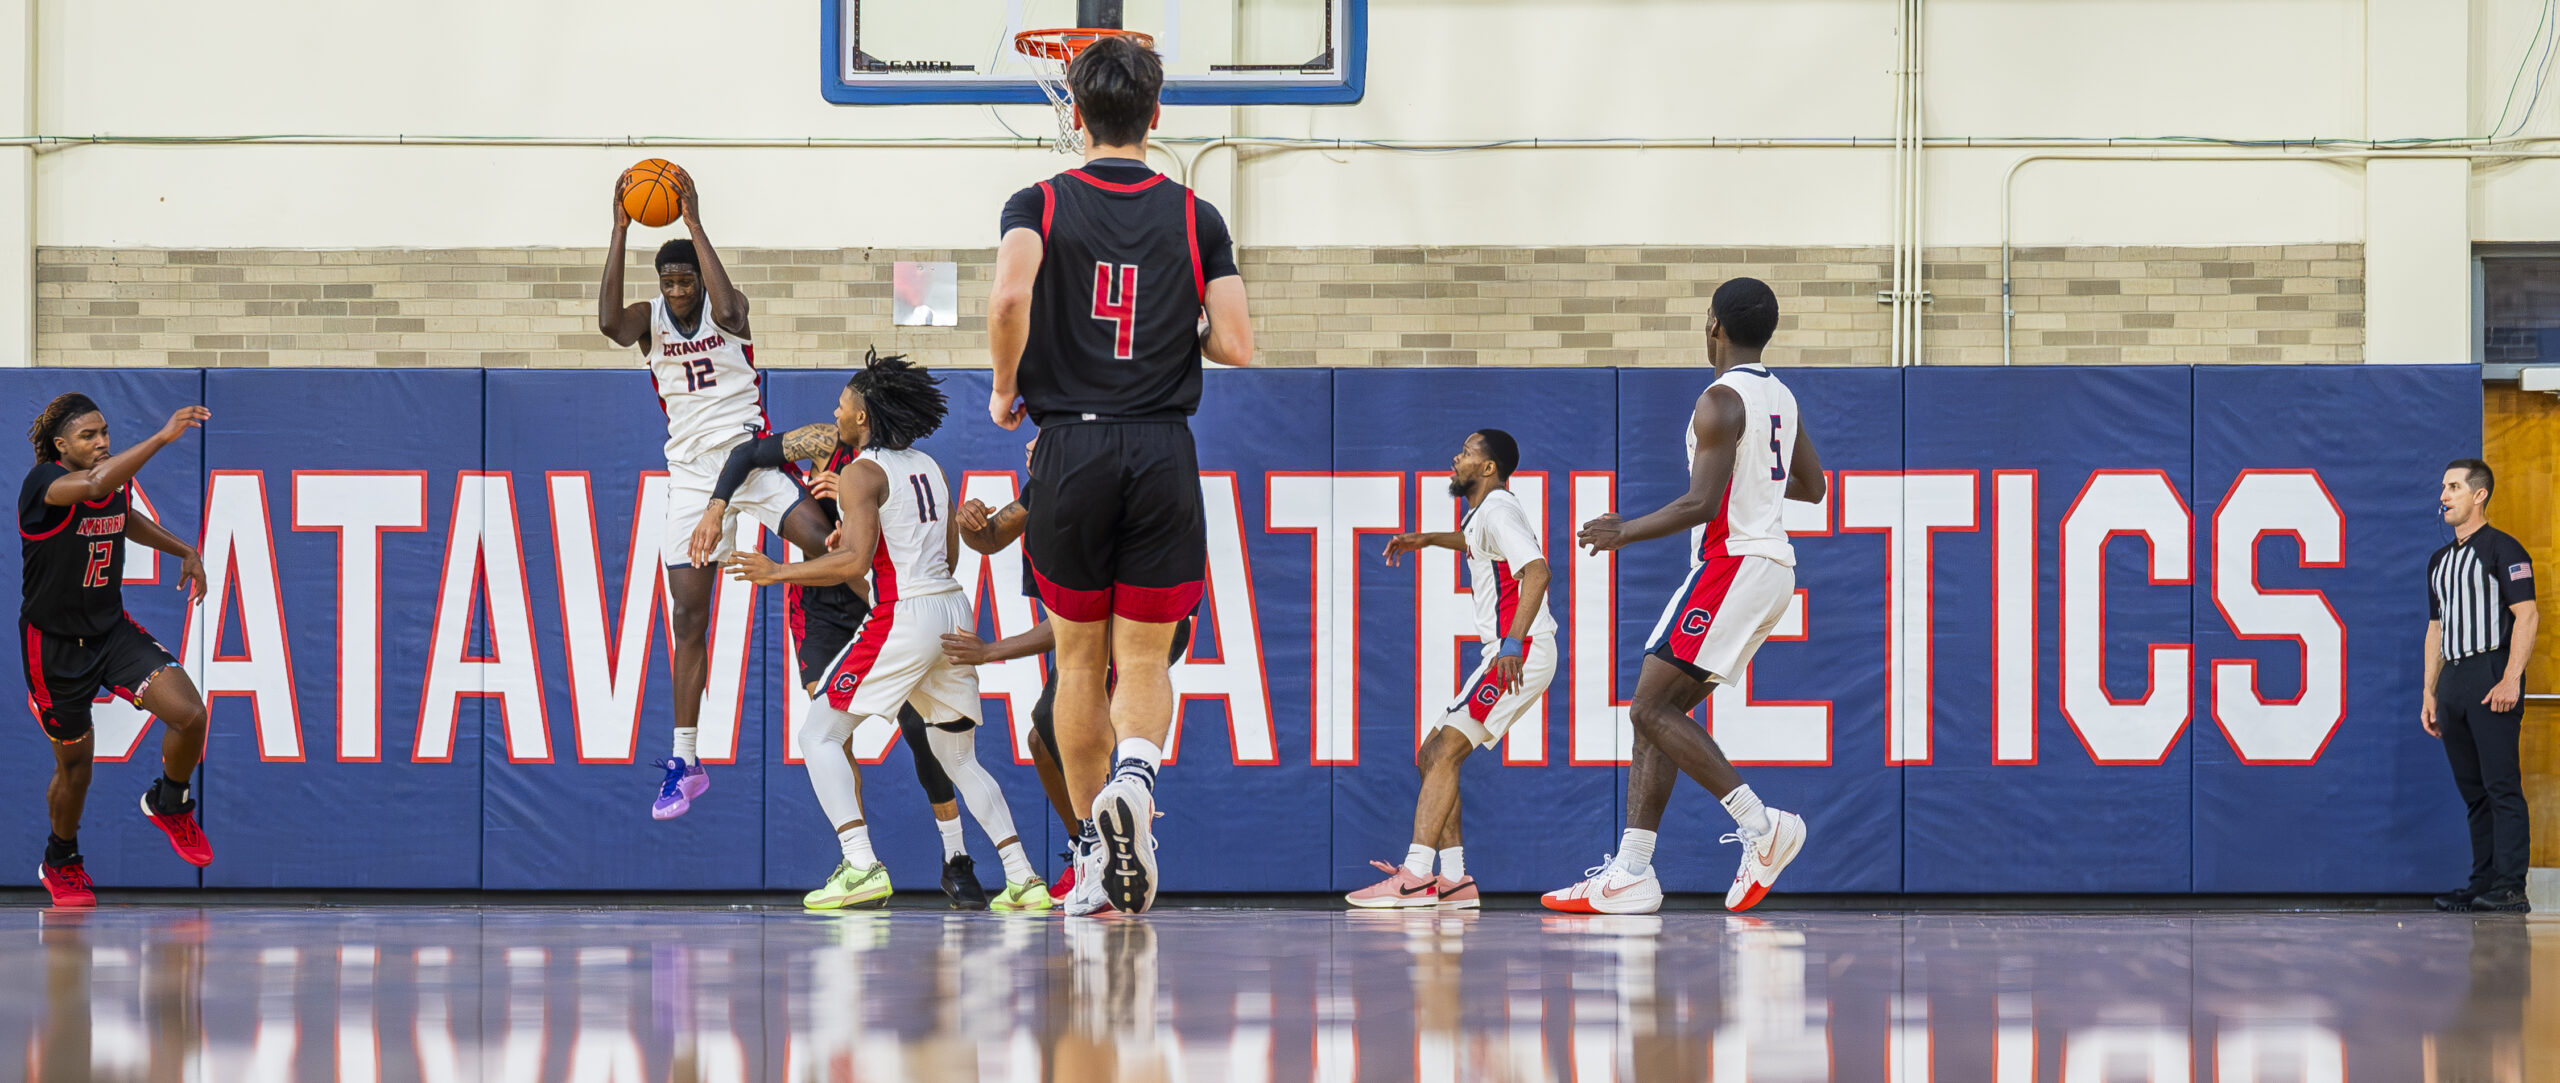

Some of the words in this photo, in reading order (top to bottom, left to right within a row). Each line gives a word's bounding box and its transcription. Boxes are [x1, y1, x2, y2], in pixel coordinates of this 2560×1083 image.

[1091, 261, 1138, 359] 4
[663, 333, 726, 356] CATAWBA
[681, 357, 717, 392] 12
[1769, 415, 1786, 481] 5
[909, 473, 938, 524] 11
[82, 540, 113, 588] 12
[28, 469, 1048, 765] ATAWA
[1681, 607, 1712, 636] C
[834, 672, 857, 693] C
[1476, 684, 1500, 706] C
